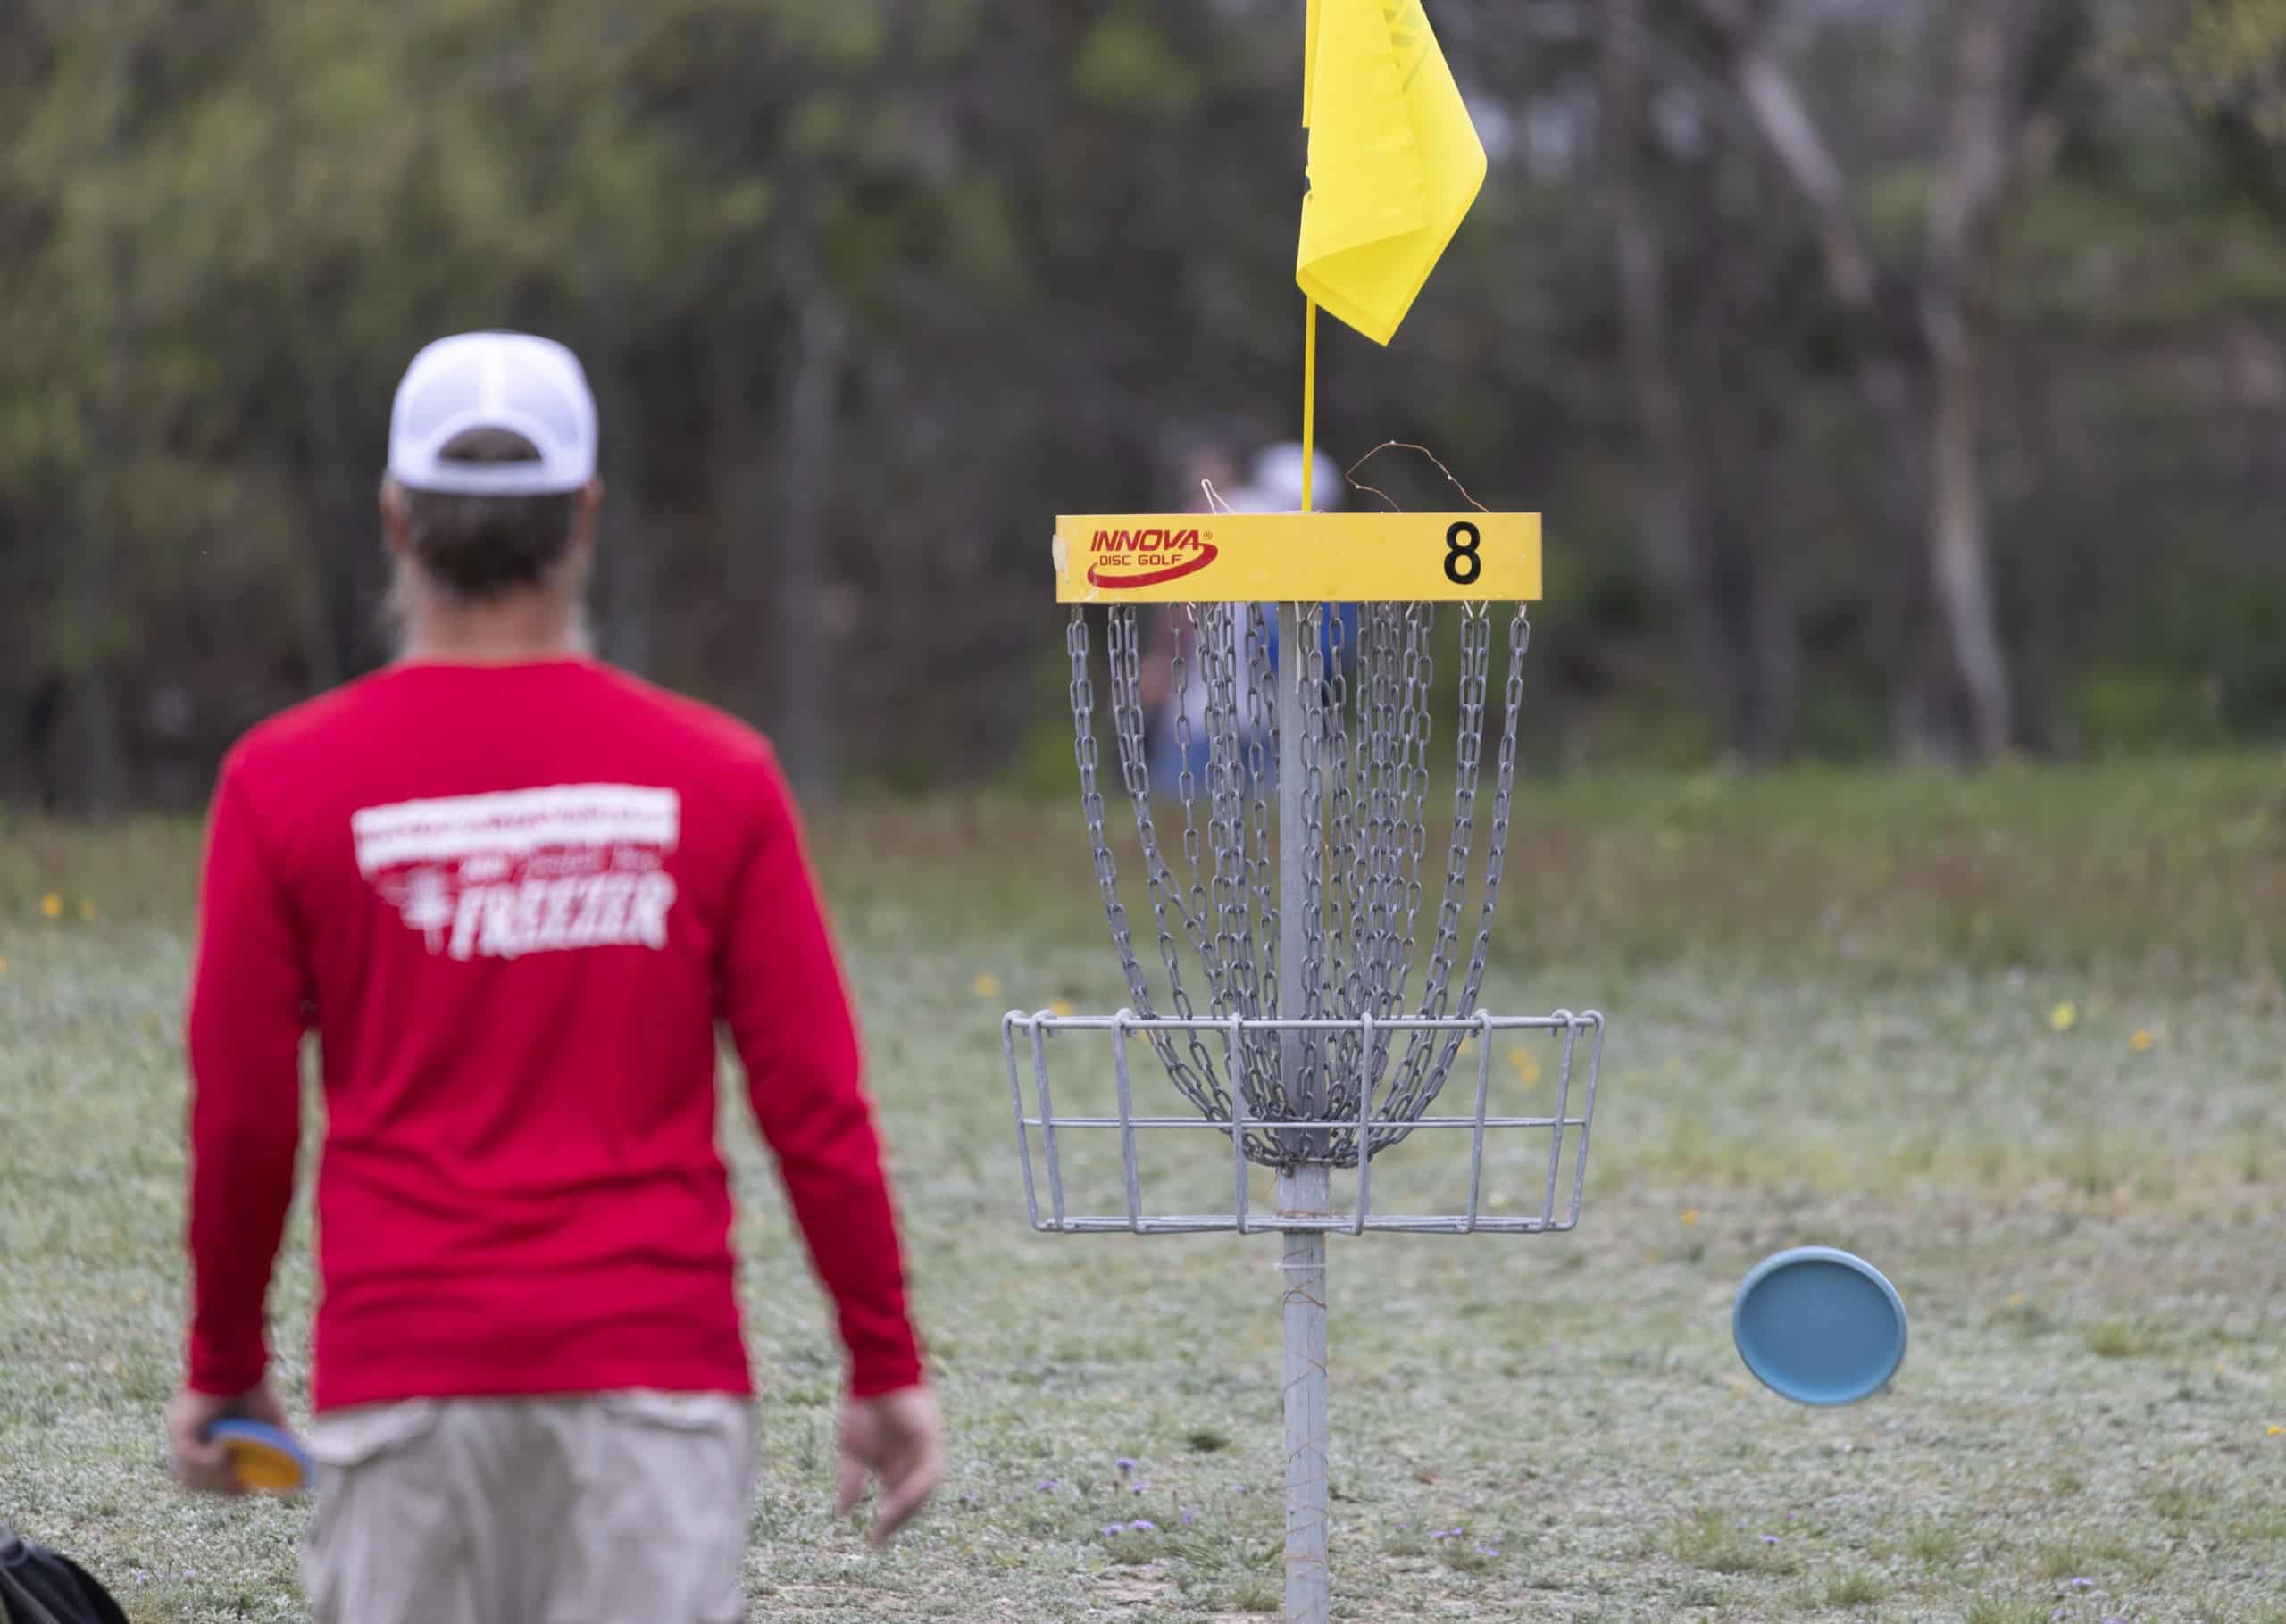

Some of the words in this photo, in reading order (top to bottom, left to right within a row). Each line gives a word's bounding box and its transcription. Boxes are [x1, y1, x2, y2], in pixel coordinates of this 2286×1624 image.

[1099, 554, 1131, 566] DISC
[1138, 554, 1183, 566] GOLF
[1444, 521, 1481, 585] 8
[447, 871, 679, 962] FREEZER
